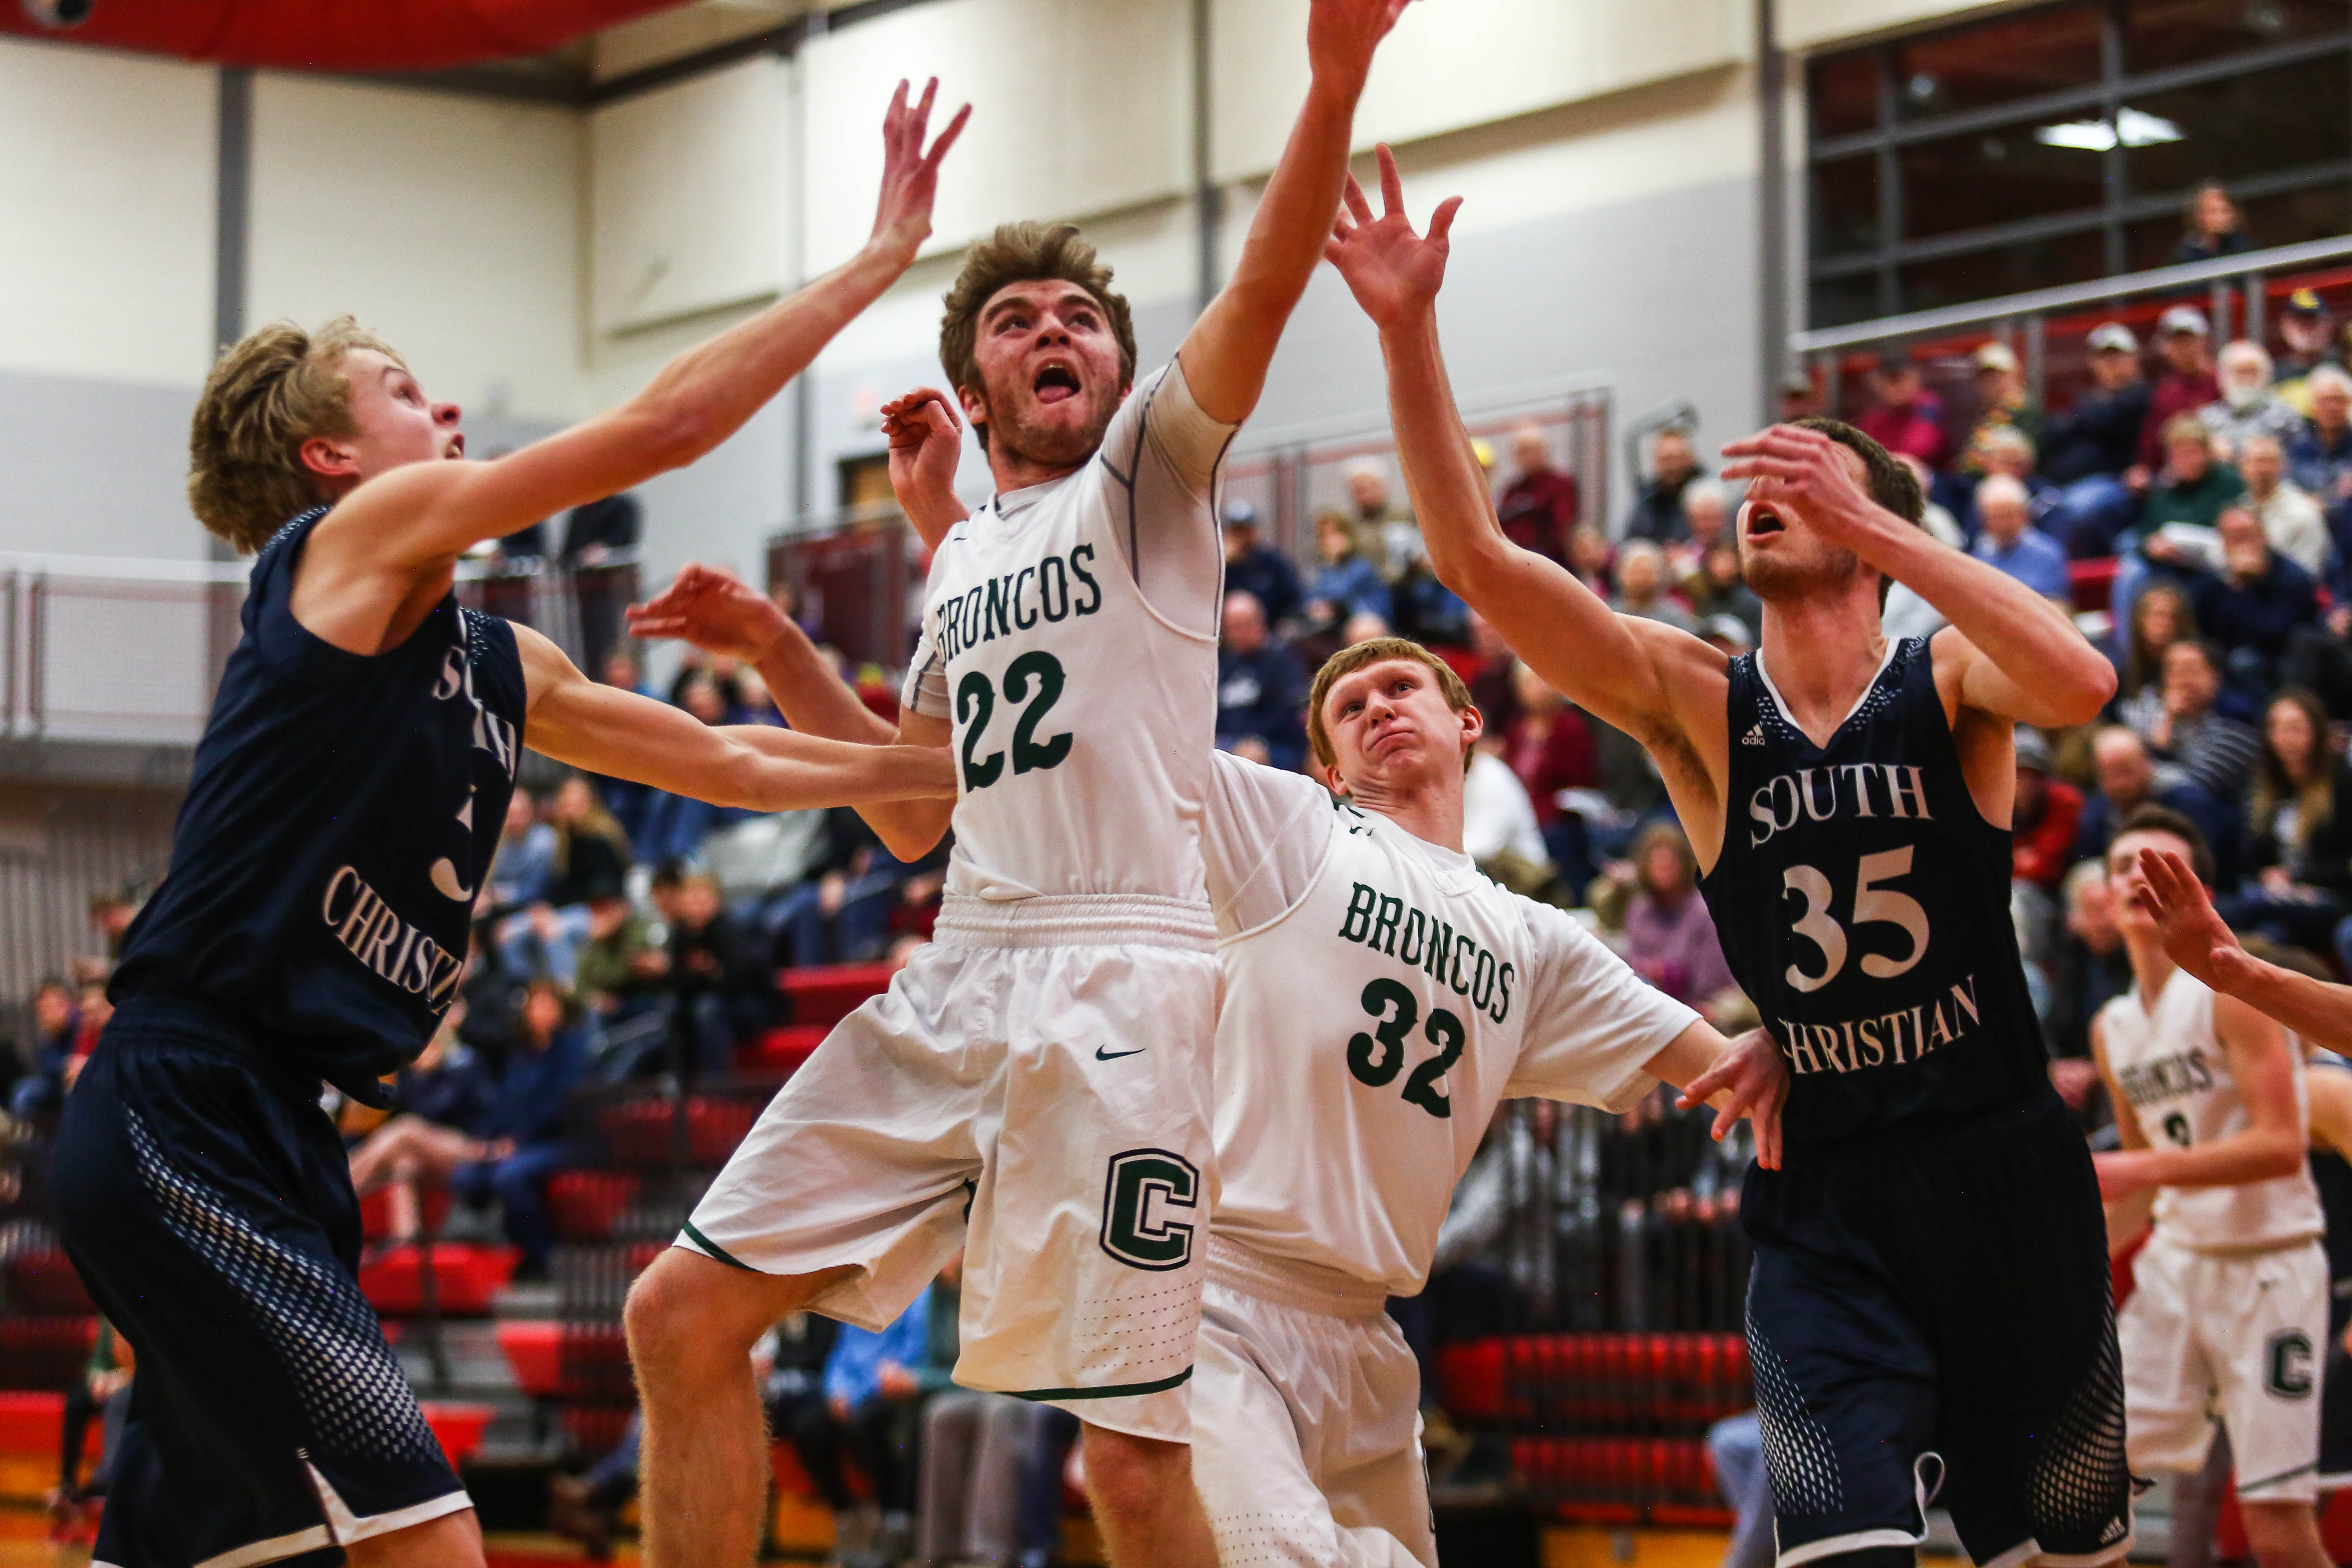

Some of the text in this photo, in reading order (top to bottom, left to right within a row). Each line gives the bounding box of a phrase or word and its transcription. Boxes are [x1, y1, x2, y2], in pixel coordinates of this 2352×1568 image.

[957, 650, 1073, 793] 22
[1750, 763, 1935, 850] SOUTH
[1338, 882, 1515, 1024] BRONCOS
[1782, 844, 1930, 993] 35
[1347, 978, 1466, 1118] 32
[1099, 1147, 1200, 1272] C
